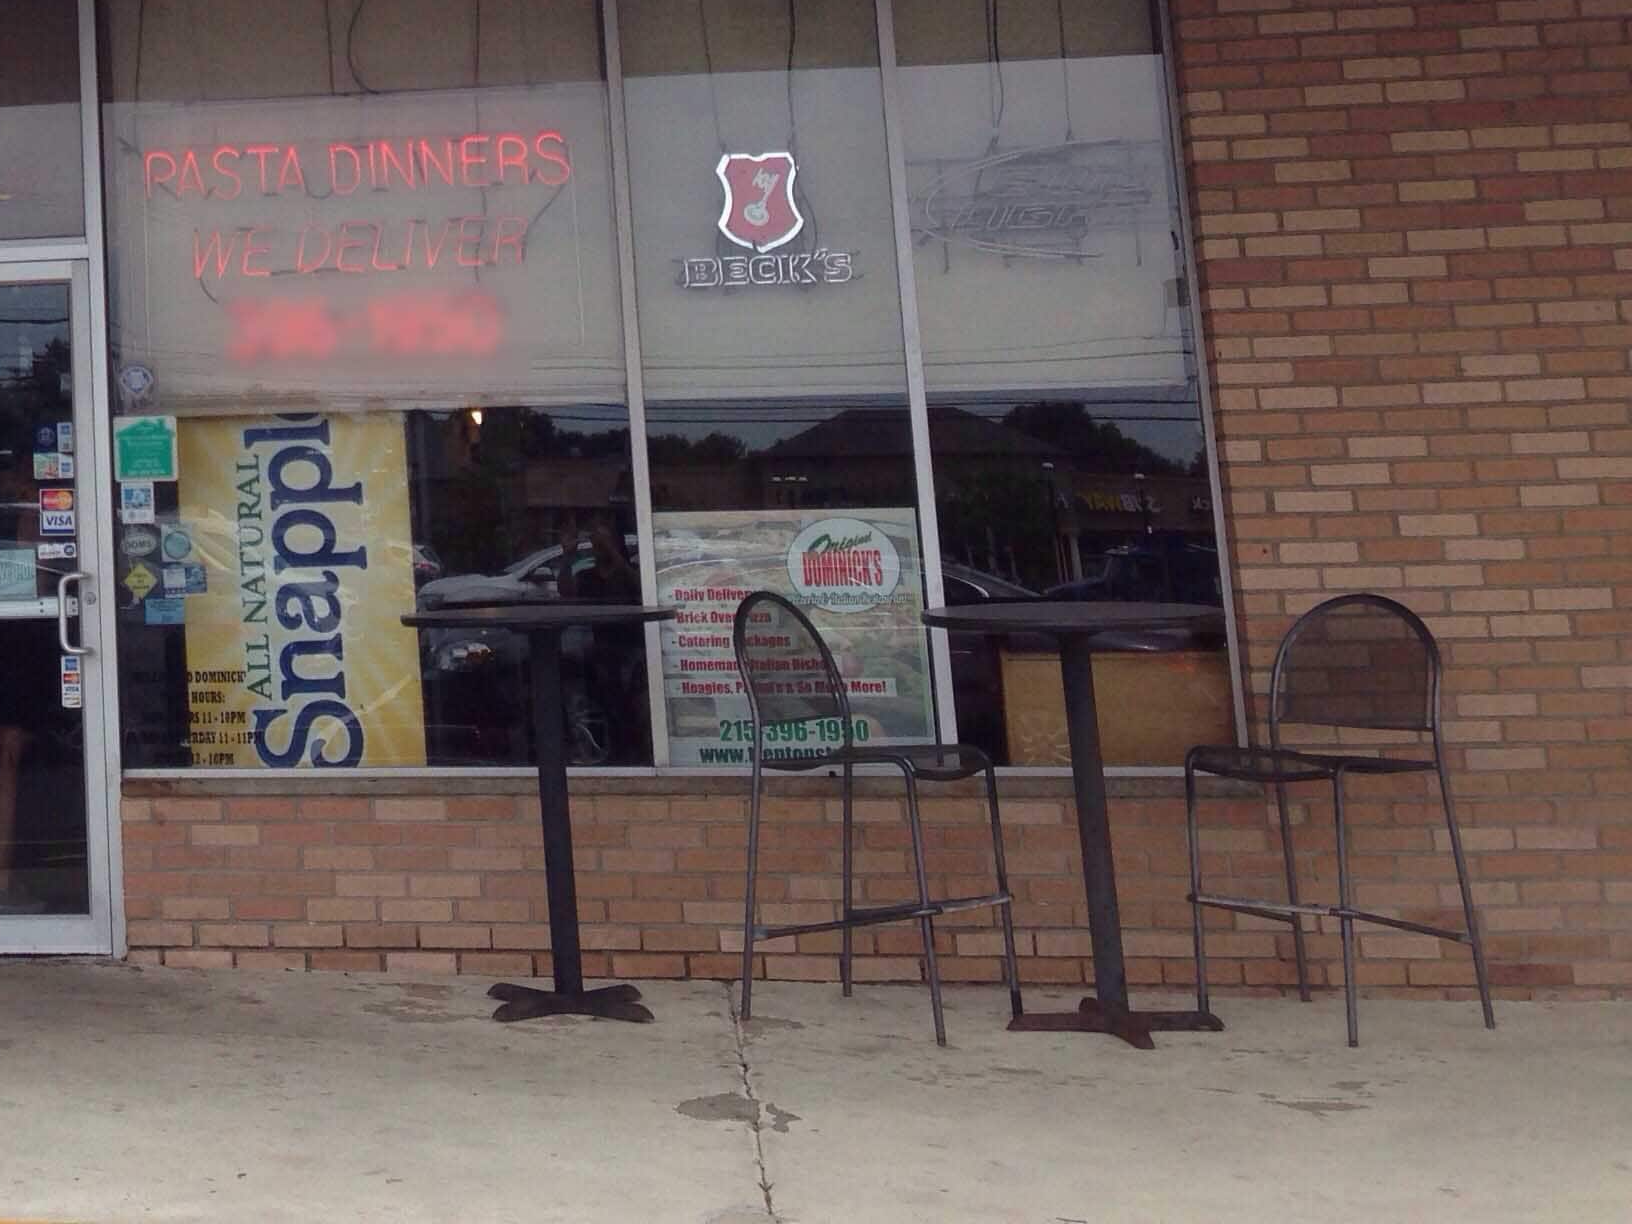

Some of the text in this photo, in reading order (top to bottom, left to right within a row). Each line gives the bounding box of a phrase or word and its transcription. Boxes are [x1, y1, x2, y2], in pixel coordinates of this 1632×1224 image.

[144, 130, 571, 201] PASTA DINNERS
[192, 215, 530, 279] WE DELIVER
[683, 248, 853, 288] BECK'S
[45, 515, 73, 526] VISA
[802, 548, 883, 587] DOMINICK'S
[236, 454, 273, 700] ALL NATURAL
[244, 412, 368, 768] Snappl
[674, 588, 705, 601] Daily
[676, 611, 708, 624] Brick
[678, 635, 730, 648] Catering
[680, 659, 738, 671] Homema
[850, 680, 887, 693] More!
[191, 691, 226, 704] HOURS:
[719, 719, 870, 742] 215396-190
